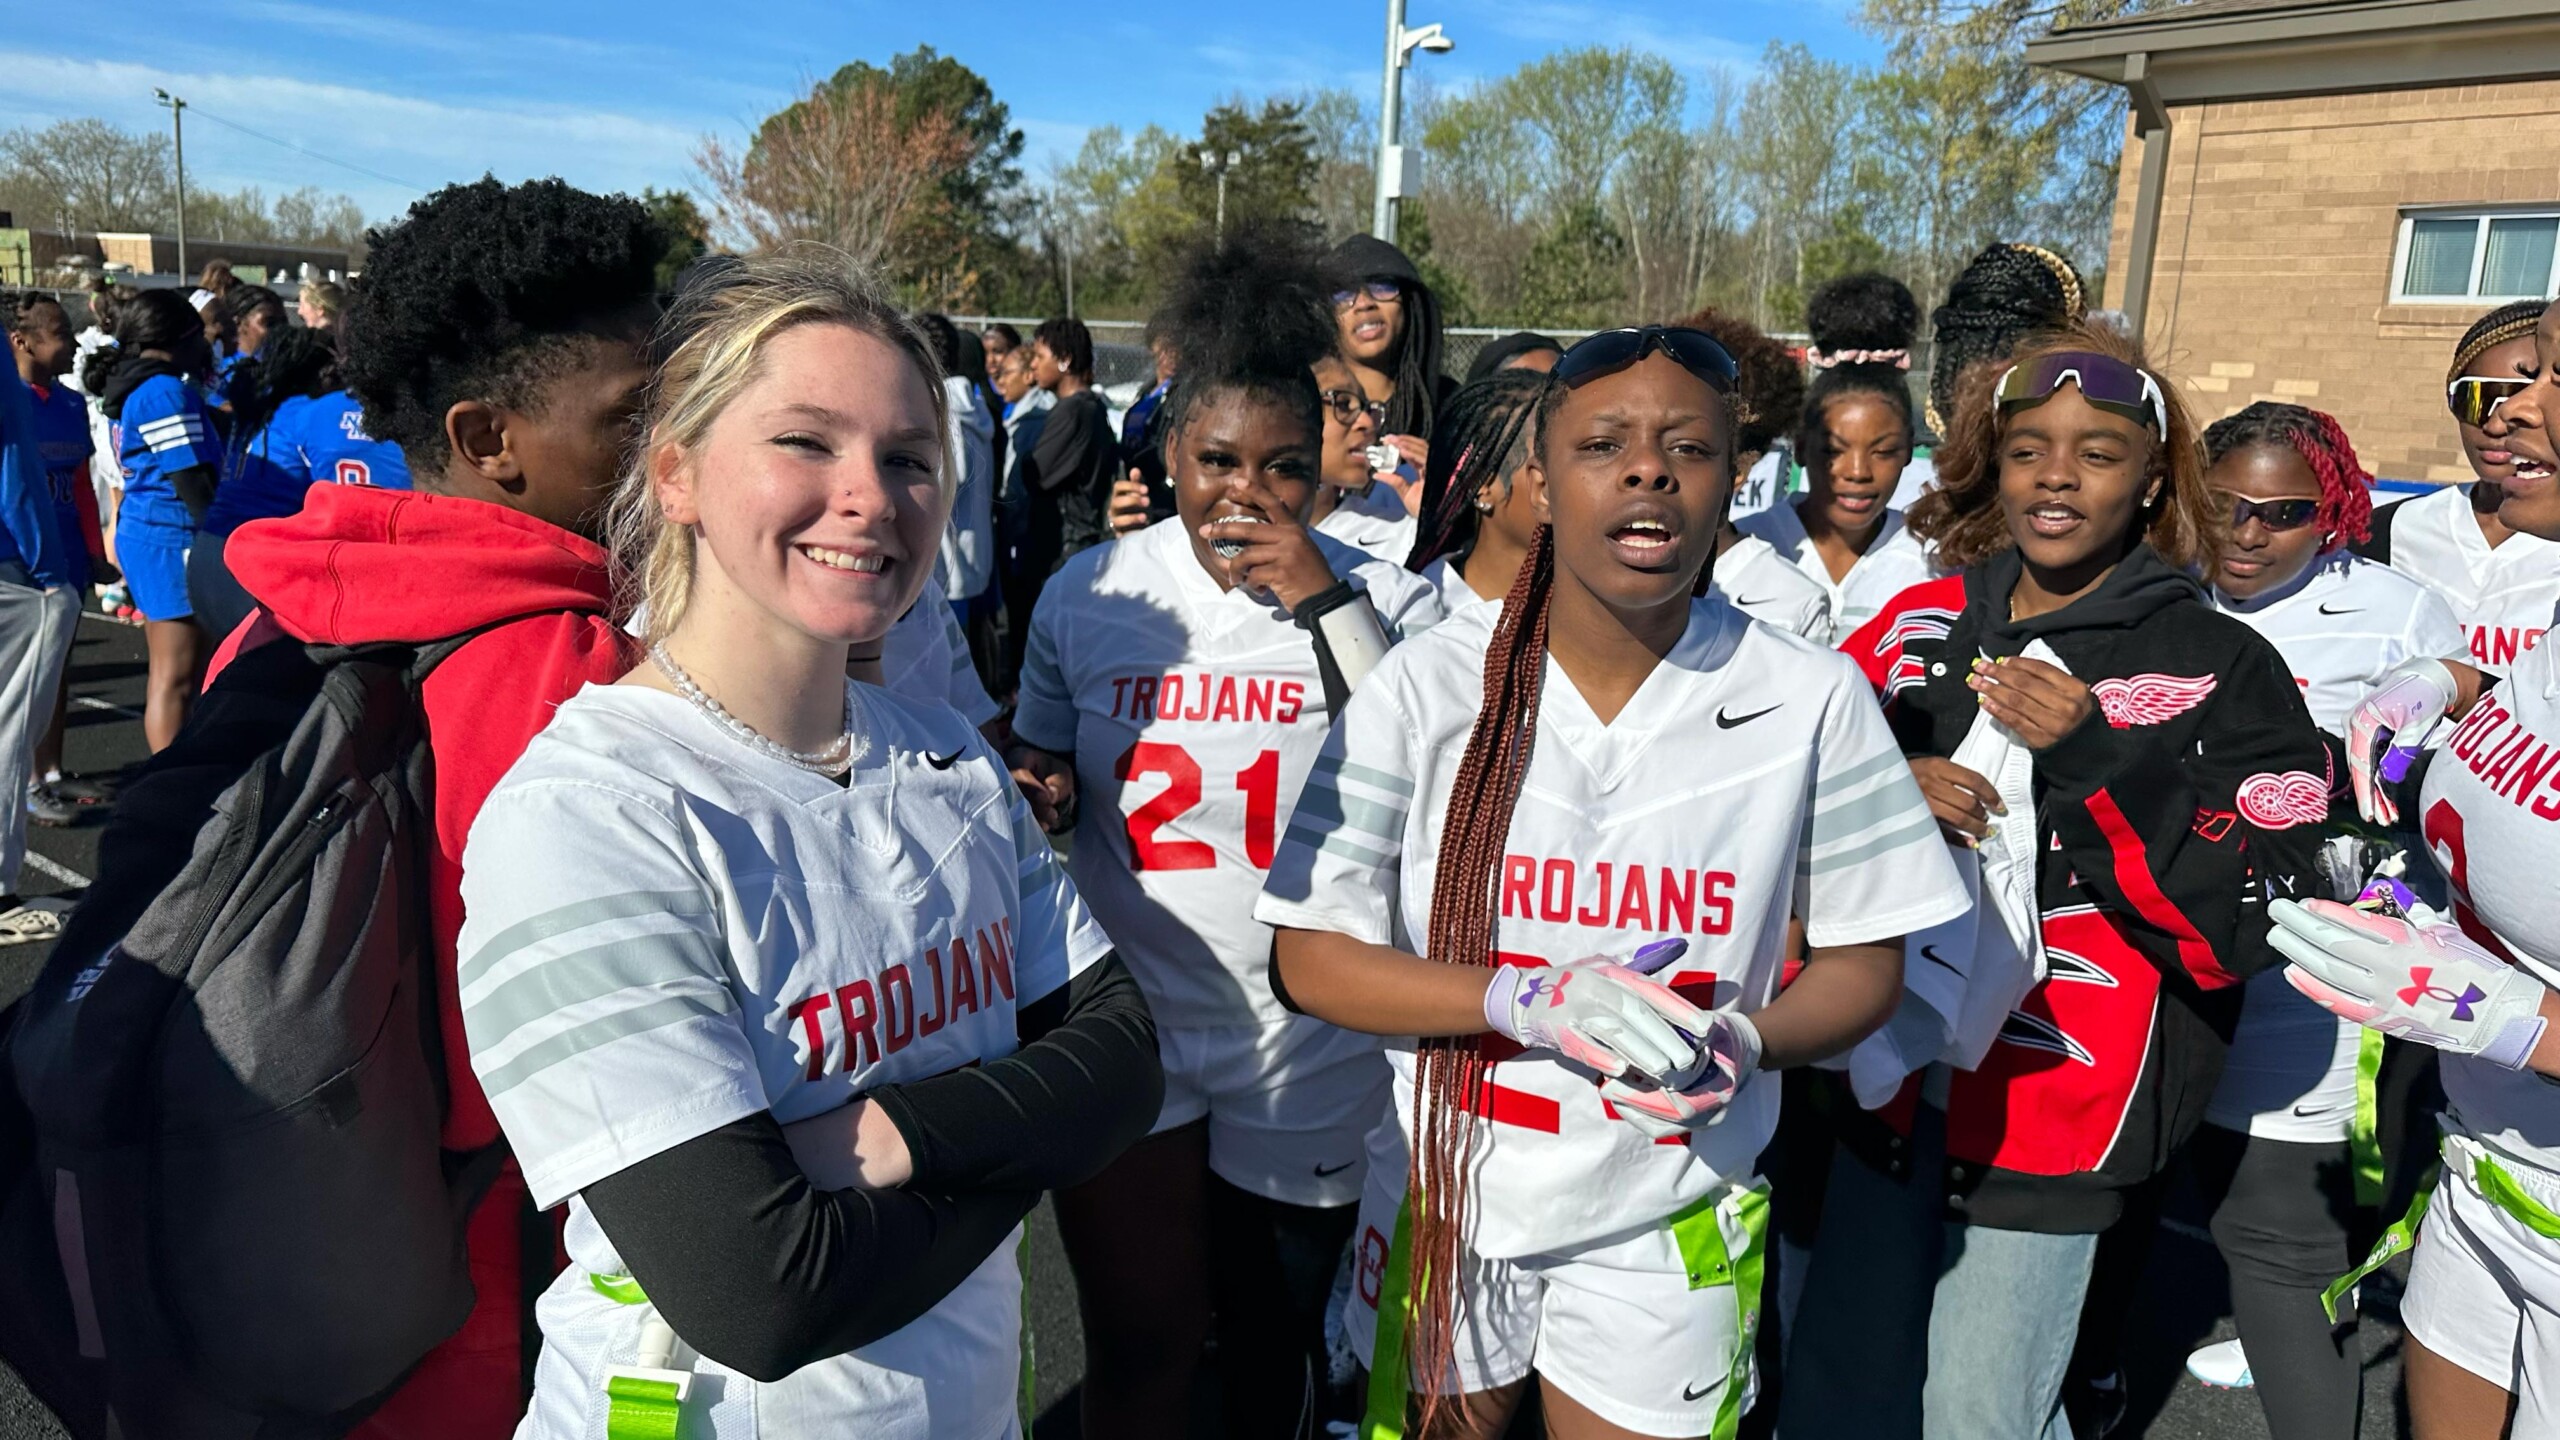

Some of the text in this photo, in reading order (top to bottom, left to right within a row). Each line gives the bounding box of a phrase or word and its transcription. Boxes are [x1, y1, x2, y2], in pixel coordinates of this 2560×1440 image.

[1733, 479, 1766, 508] EK
[2459, 624, 2546, 666] ANS
[1111, 673, 1305, 724] TROJANS
[2446, 689, 2560, 822] ROJANS
[1114, 742, 1280, 871] 21
[1501, 855, 1736, 936] ROJANS
